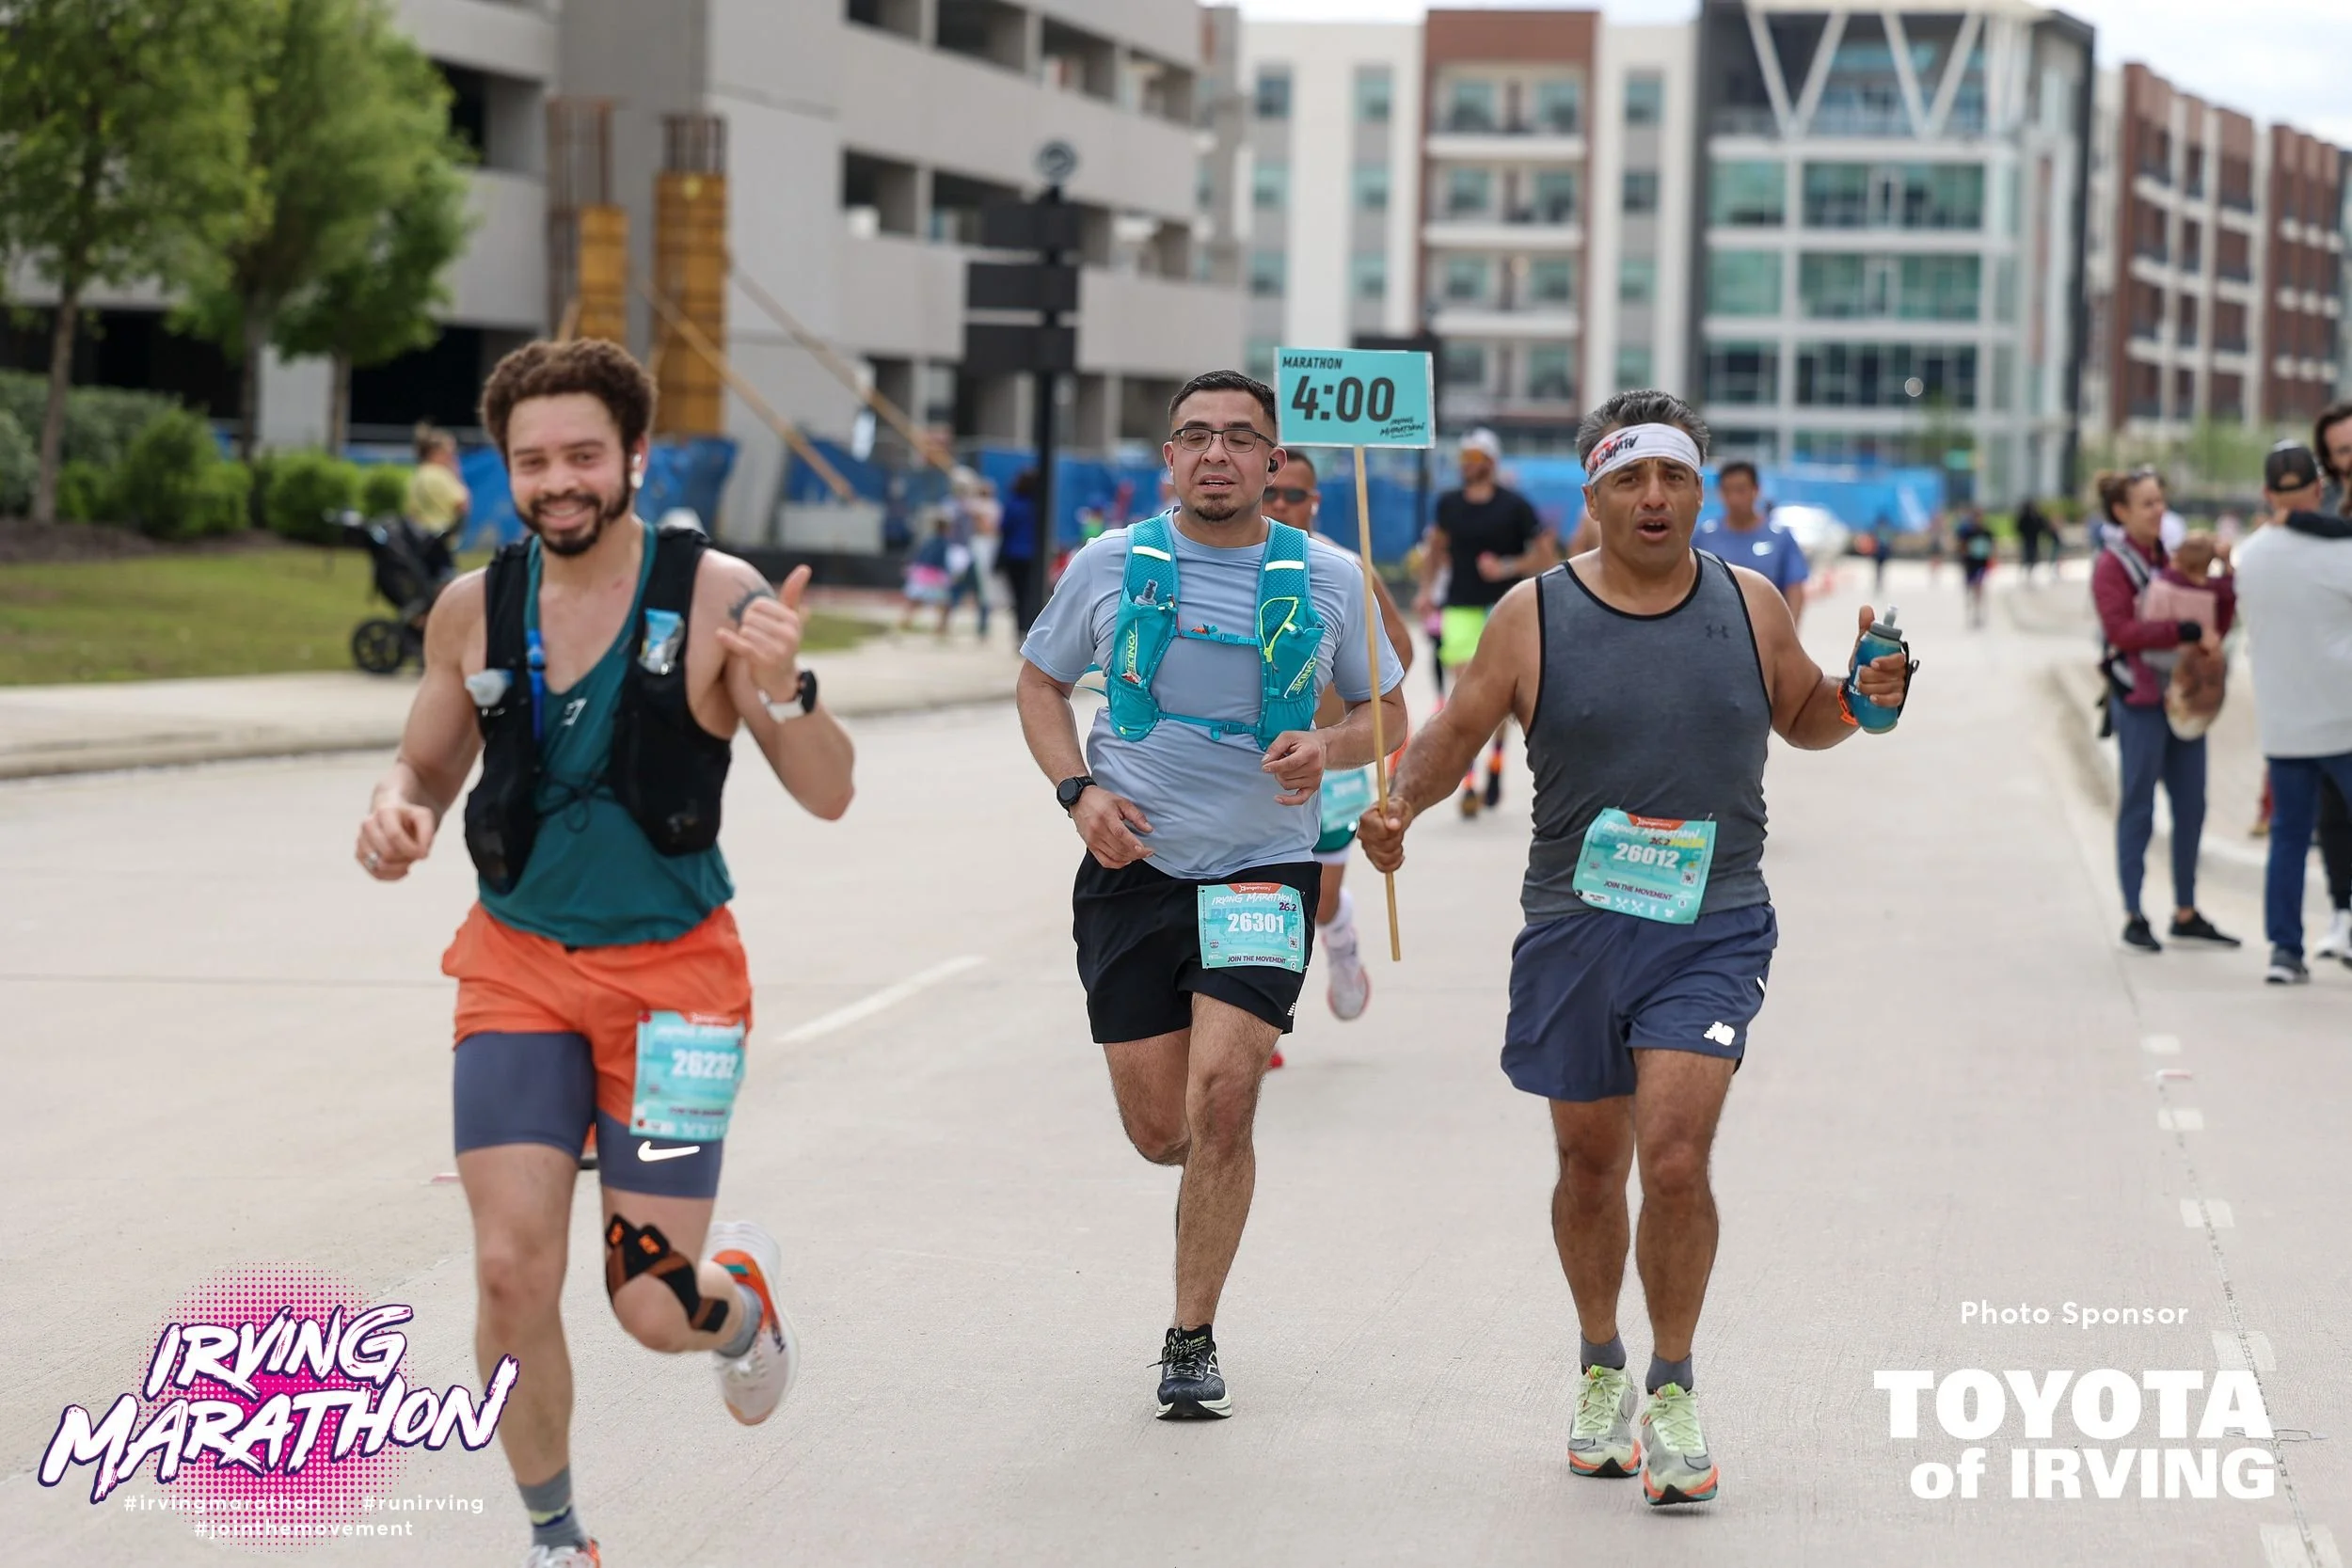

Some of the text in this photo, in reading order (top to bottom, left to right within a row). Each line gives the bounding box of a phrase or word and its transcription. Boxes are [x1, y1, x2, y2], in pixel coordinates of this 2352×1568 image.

[1282, 356, 1343, 370] MARATHON
[1292, 375, 1395, 422] 4:00
[1613, 843, 1680, 869] 26012
[1212, 893, 1293, 905] IRVING MARATHON
[1621, 883, 1634, 893] THE
[1635, 887, 1673, 900] MOVEMENT
[1279, 902, 1297, 911] 26.2
[1227, 912, 1284, 933] 26301
